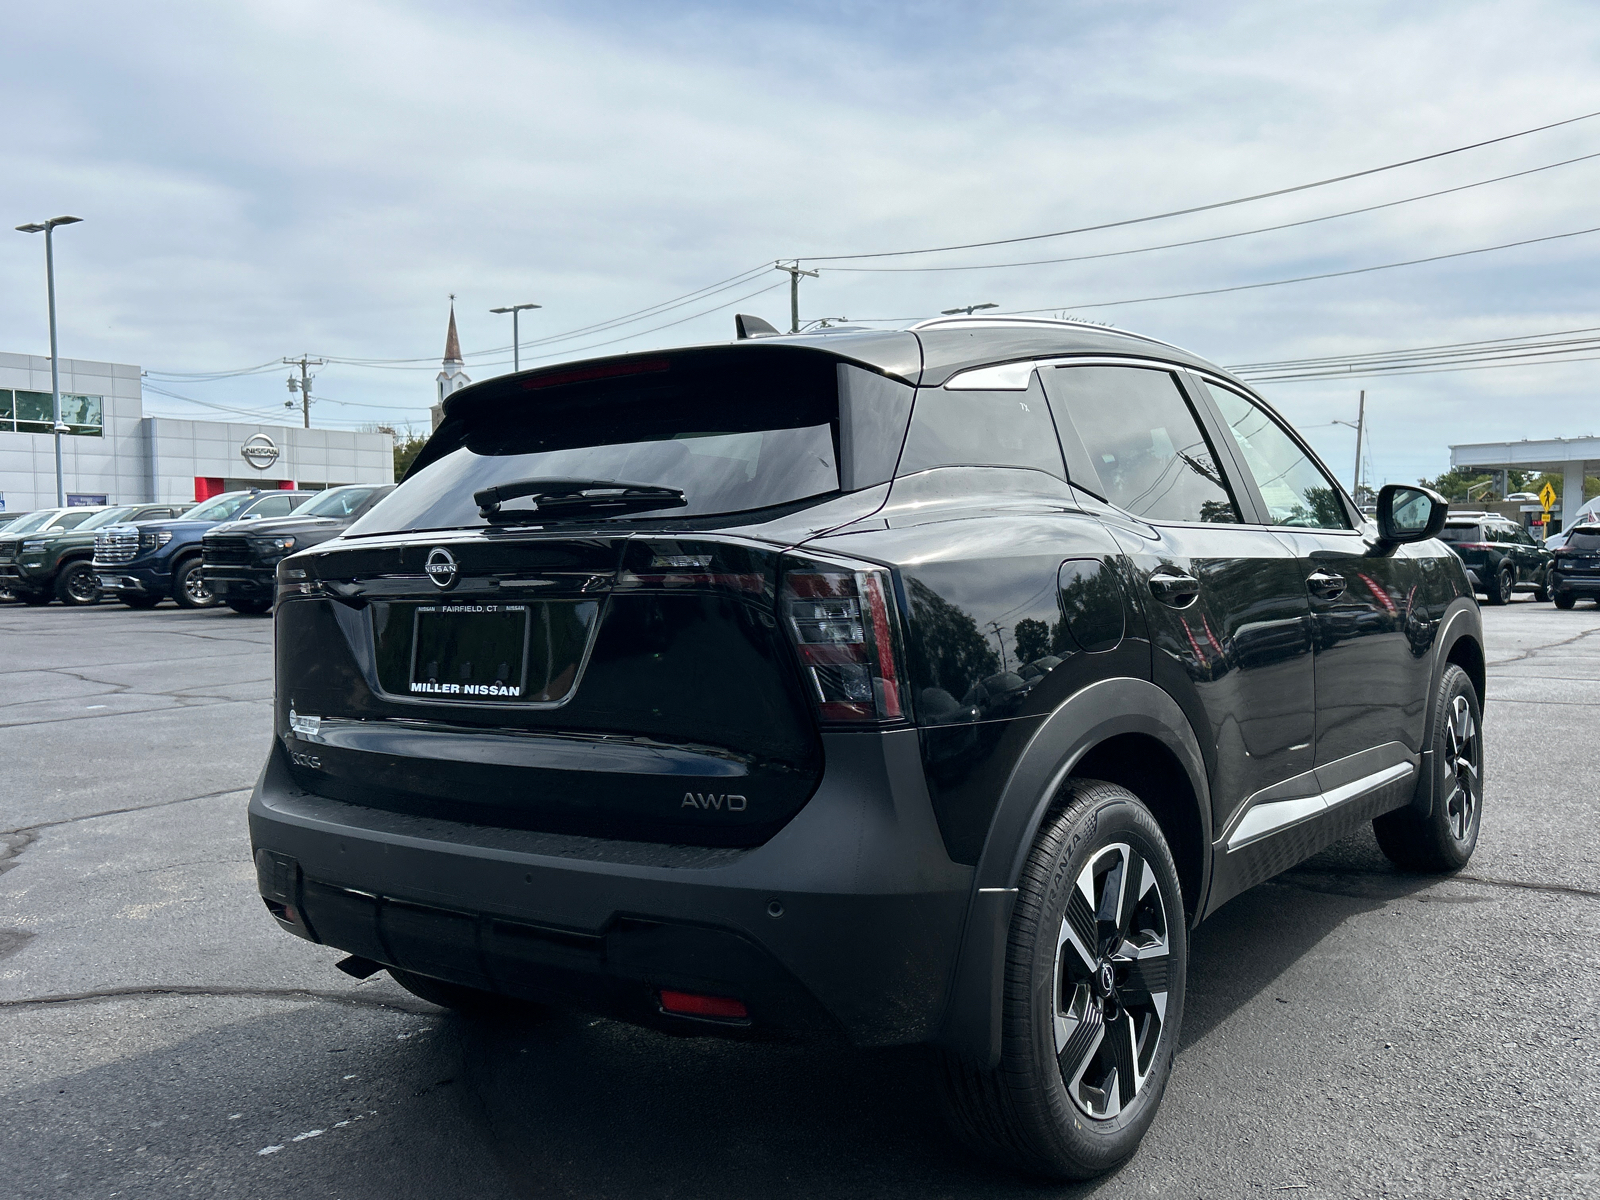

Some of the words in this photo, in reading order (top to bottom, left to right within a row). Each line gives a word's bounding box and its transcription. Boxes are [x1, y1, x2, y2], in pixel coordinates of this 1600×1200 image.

[246, 447, 277, 455] NISSAN
[425, 565, 456, 573] NISSAN
[442, 605, 485, 613] FAIRFIELD,
[410, 682, 460, 694] MILLER
[463, 684, 520, 696] NISSAN
[681, 792, 747, 812] AWD
